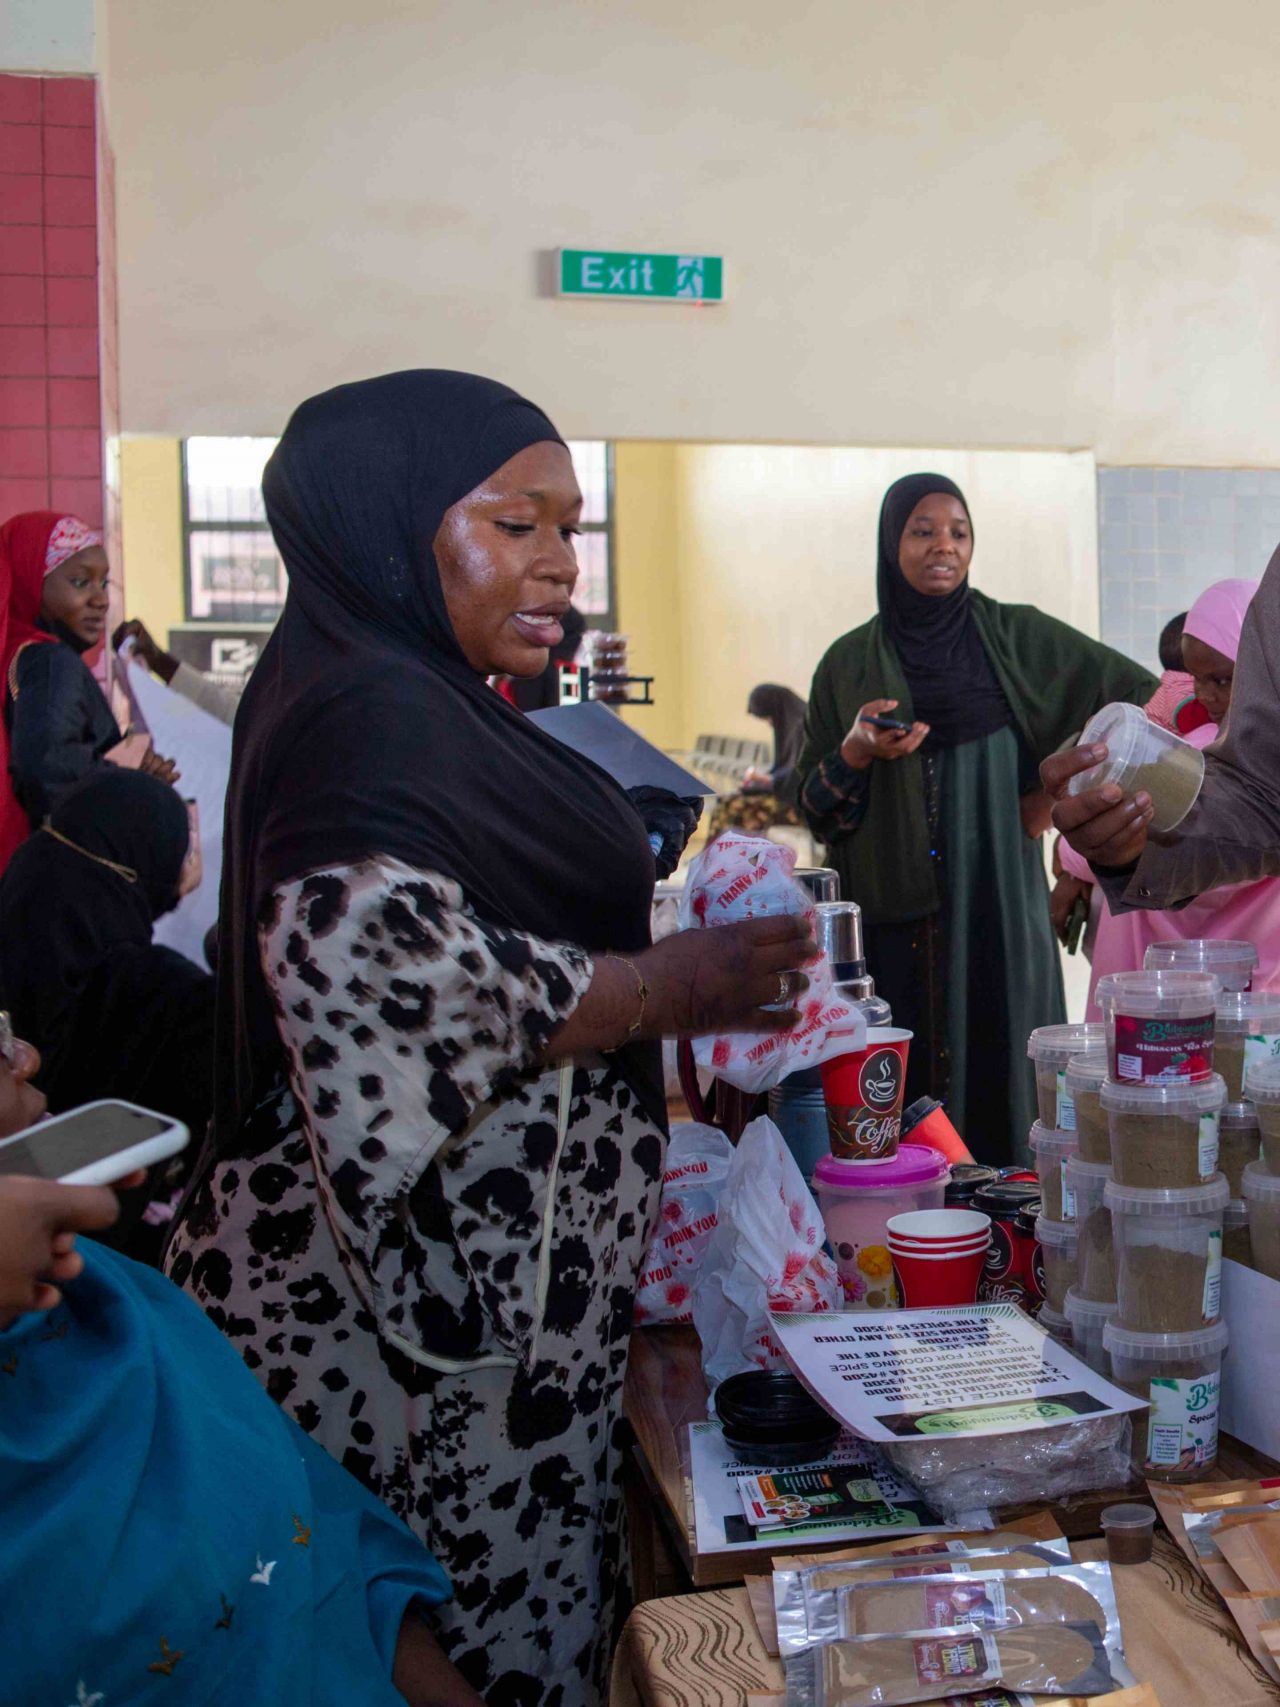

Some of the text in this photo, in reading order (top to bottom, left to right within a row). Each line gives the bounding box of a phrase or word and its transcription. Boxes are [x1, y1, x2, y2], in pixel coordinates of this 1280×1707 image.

[581, 257, 653, 291] Exit
[663, 1167, 684, 1183] ANK
[695, 1213, 719, 1236] YOU
[648, 1265, 673, 1285] YOU
[910, 1321, 952, 1330] SPICES
[953, 1318, 977, 1327] THE
[982, 1317, 996, 1325] OF
[853, 1325, 893, 1333] #3500
[941, 1326, 990, 1336] MEDIUM
[814, 1335, 856, 1343] OTHER
[858, 1334, 884, 1342] ANY
[886, 1333, 911, 1341] FOR
[912, 1331, 939, 1339] SIZE
[977, 1331, 1012, 1341] SPICE
[917, 1335, 960, 1346] #2000
[965, 1338, 1008, 1348] SMALL
[883, 1349, 909, 1357] ANY
[911, 1346, 936, 1355] FOR
[938, 1344, 961, 1352] SIZE
[829, 1345, 1036, 1372] PRICE LIST FOR COOKING SPICE
[837, 1352, 862, 1360] THE
[865, 1351, 879, 1359] OF
[975, 1355, 1028, 1367] MEDIUM
[889, 1367, 913, 1376] TEA
[916, 1361, 975, 1373] HIBISCUS
[997, 1363, 1038, 1374] SMALL
[842, 1371, 887, 1381] #4500
[908, 1374, 935, 1383] TEA
[936, 1367, 993, 1380] HIBISCUS
[995, 1369, 1047, 1382] MEDIUM
[862, 1377, 906, 1387] #3500
[913, 1382, 940, 1391] TEA
[944, 1376, 992, 1387] SPECIAL
[1016, 1376, 1057, 1387] SMALL
[864, 1386, 911, 1396] #4000
[933, 1388, 958, 1396] TEA
[961, 1381, 1014, 1393] SPECIAL
[885, 1391, 930, 1402] #3000
[921, 1387, 1032, 1406] PRICE LIST
[831, 1453, 860, 1461] FOR
[726, 1468, 771, 1478] #4500
